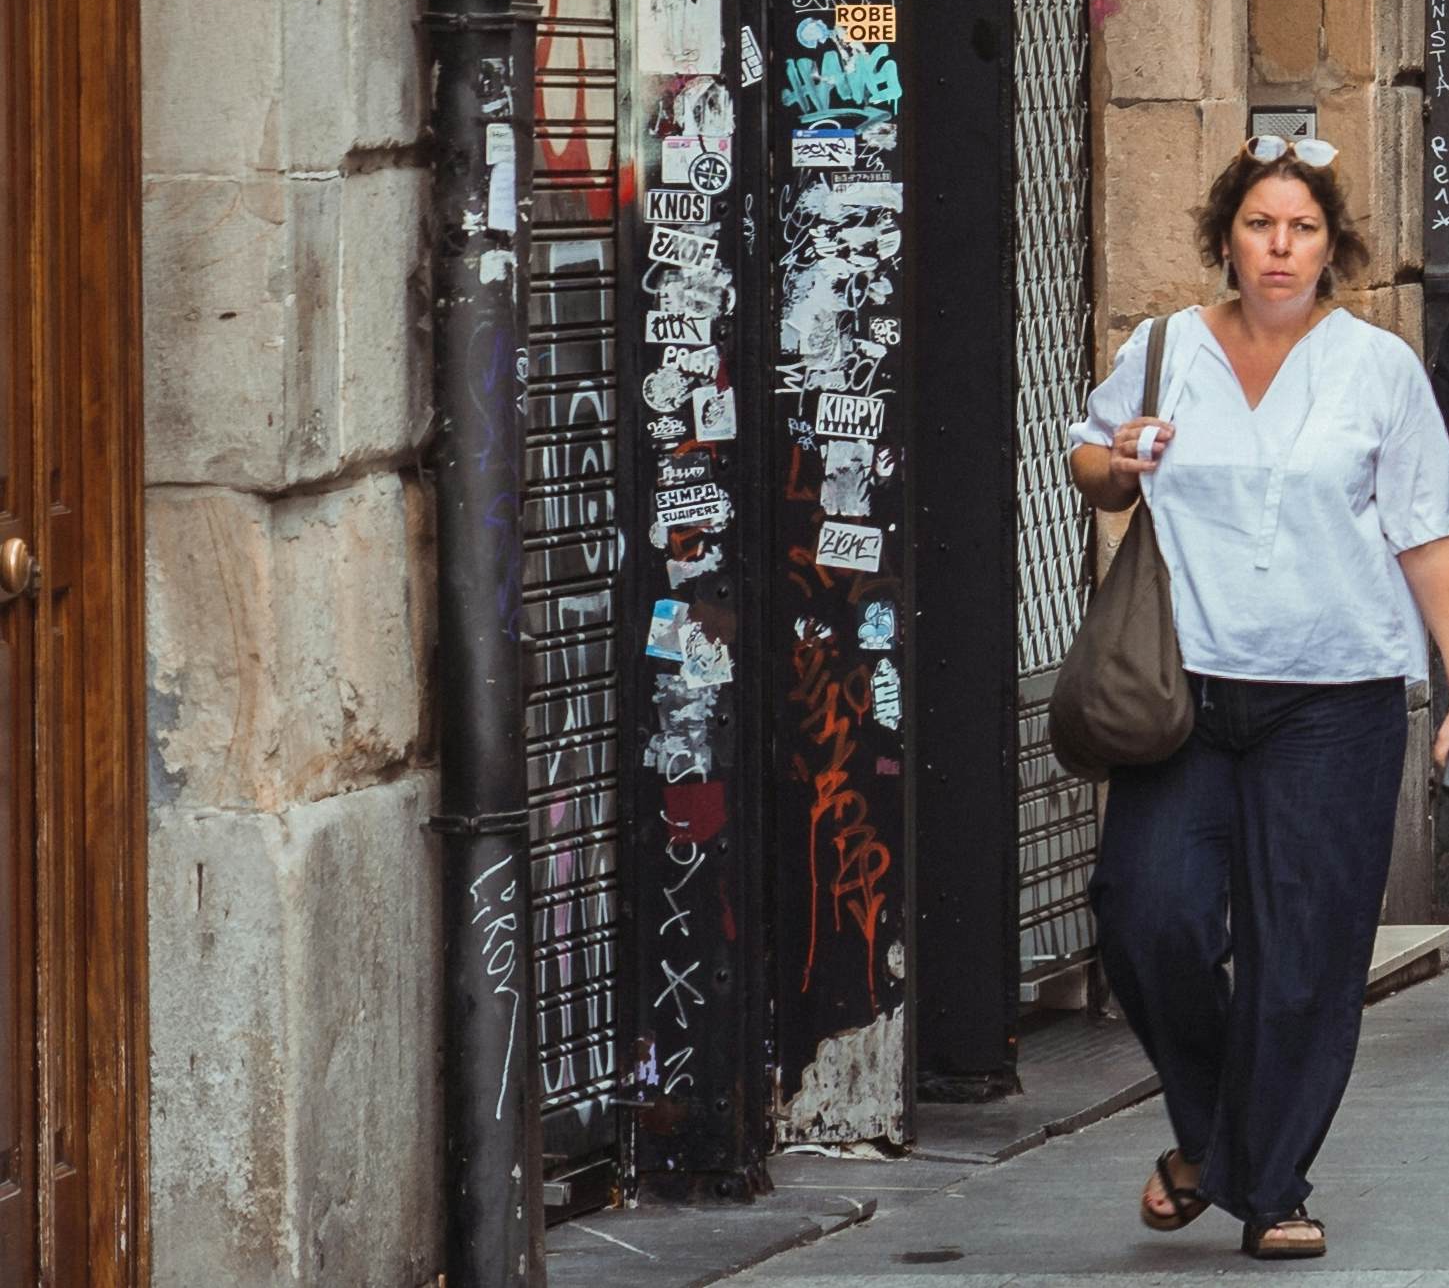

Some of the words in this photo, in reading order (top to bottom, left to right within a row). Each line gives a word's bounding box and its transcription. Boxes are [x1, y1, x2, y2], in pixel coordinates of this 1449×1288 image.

[837, 7, 894, 23] ROBE
[843, 25, 894, 41] ORE
[650, 194, 704, 221] KNOS
[821, 396, 882, 426] KIRPY
